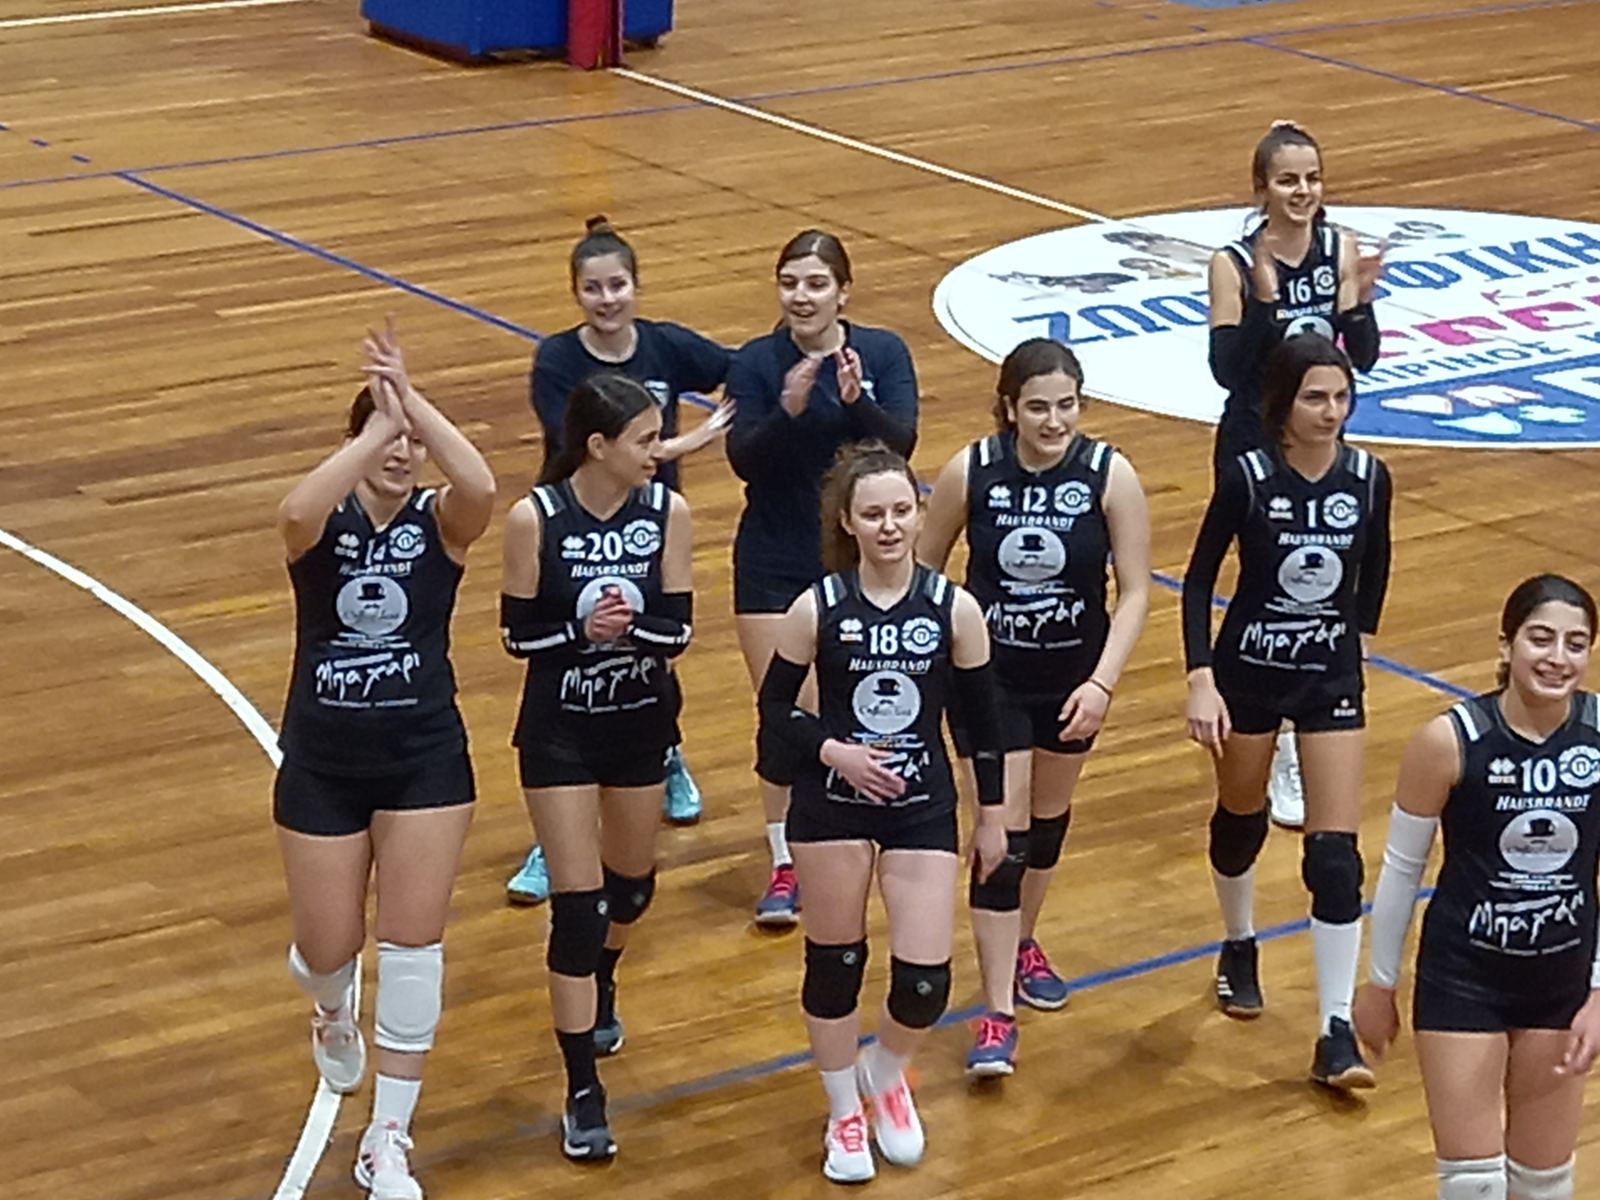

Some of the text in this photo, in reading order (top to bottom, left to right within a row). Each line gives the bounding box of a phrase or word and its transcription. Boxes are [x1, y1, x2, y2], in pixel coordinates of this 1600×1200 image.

[1287, 277, 1311, 305] 16
[1022, 485, 1047, 513] 12
[1306, 499, 1317, 528] 1
[586, 531, 623, 562] 20
[868, 624, 898, 655] 18
[1520, 758, 1556, 793] 10
